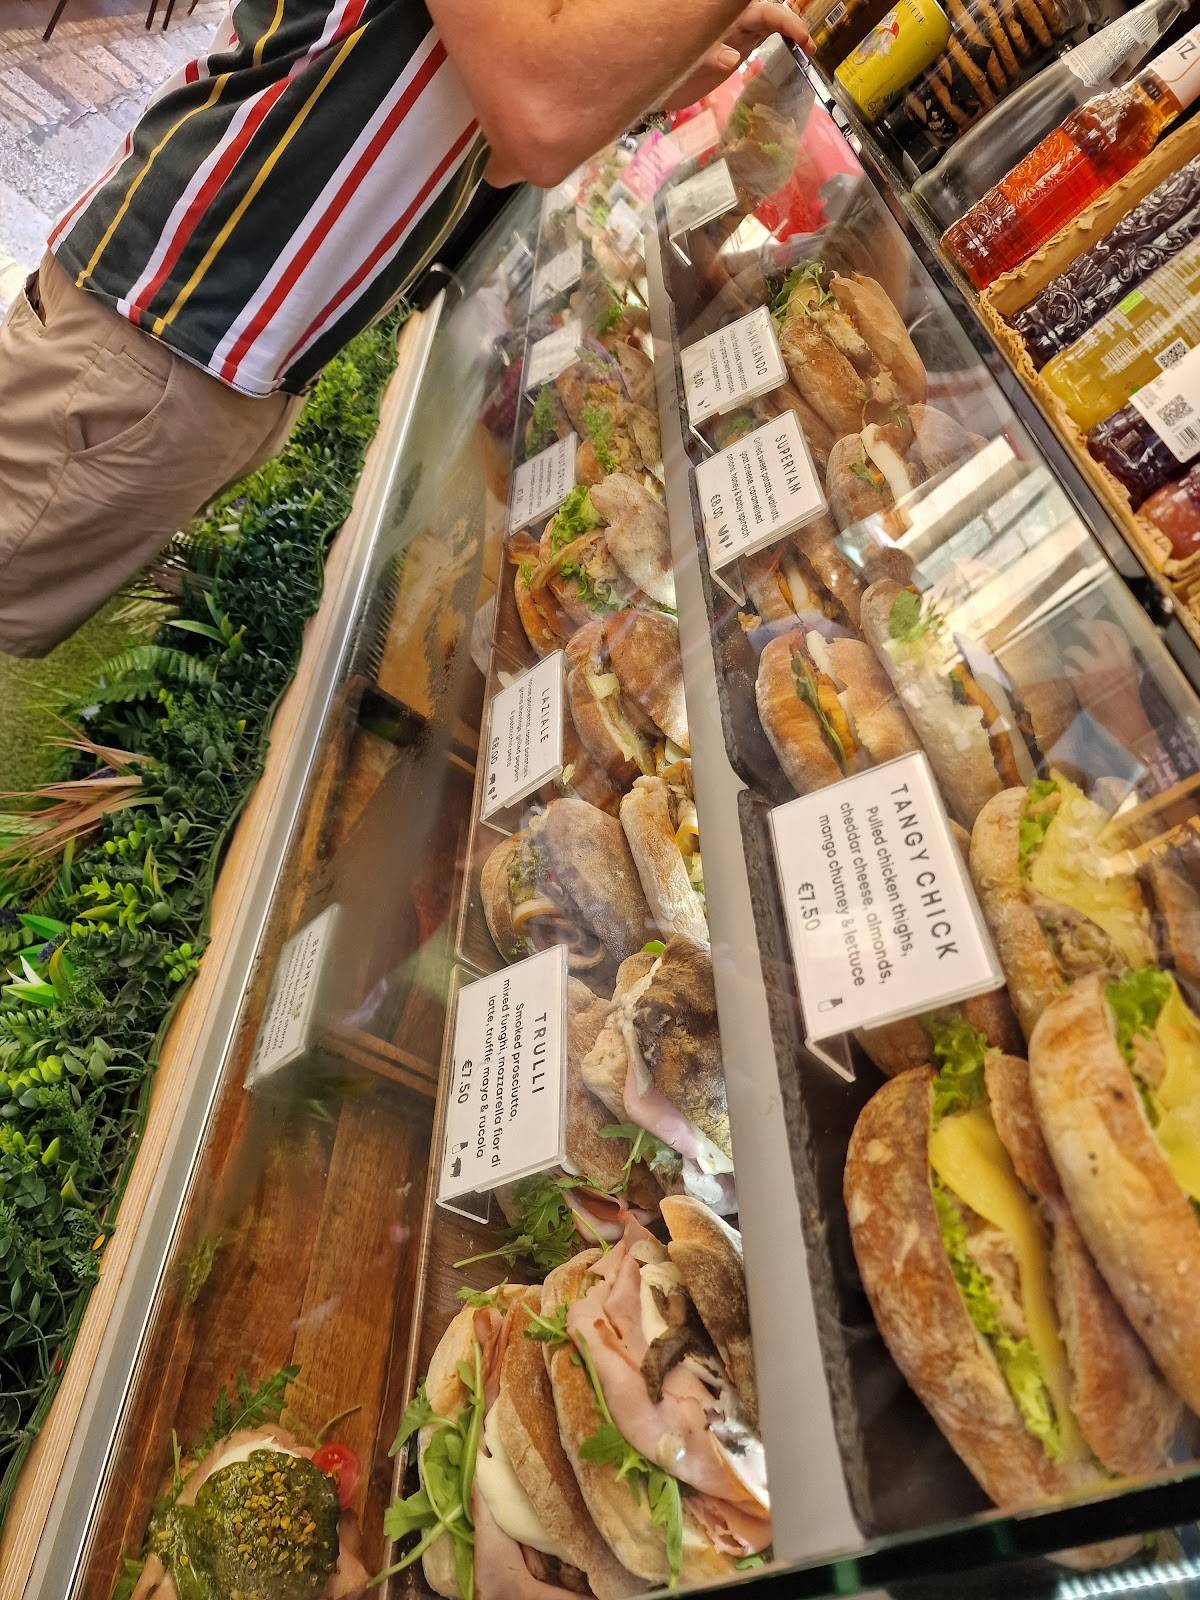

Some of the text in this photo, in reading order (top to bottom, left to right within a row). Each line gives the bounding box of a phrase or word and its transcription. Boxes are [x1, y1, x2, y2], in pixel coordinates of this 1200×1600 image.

[752, 345, 768, 376] SANDO
[731, 471, 740, 492] honey
[743, 463, 754, 486] cheese,
[757, 454, 768, 474] sweet
[759, 472, 772, 496] potato,
[775, 434, 801, 495] SUPERYAM
[710, 494, 724, 520] €8.00
[735, 494, 744, 513] baby
[737, 511, 750, 538] spinach
[748, 485, 765, 524] caramelised
[767, 493, 779, 523] walnuts,
[540, 687, 550, 743] LAZIALE
[490, 736, 500, 765] €8.00
[840, 802, 893, 984] cheddar cheese, almonds,
[867, 806, 913, 956] Pulled chicken thighs,
[891, 784, 958, 959] TANGY CHICK
[797, 882, 820, 932] €7.50
[819, 815, 865, 986] mango chutney & lettuce
[491, 979, 512, 1168] mixed funghi, mozzarella fior di
[509, 1003, 524, 1121] Smoked prosciutto,
[532, 1013, 547, 1093] TRULLI
[458, 1060, 473, 1104] €7.50
[476, 995, 497, 1158] latte, truffle mayo & rucola
